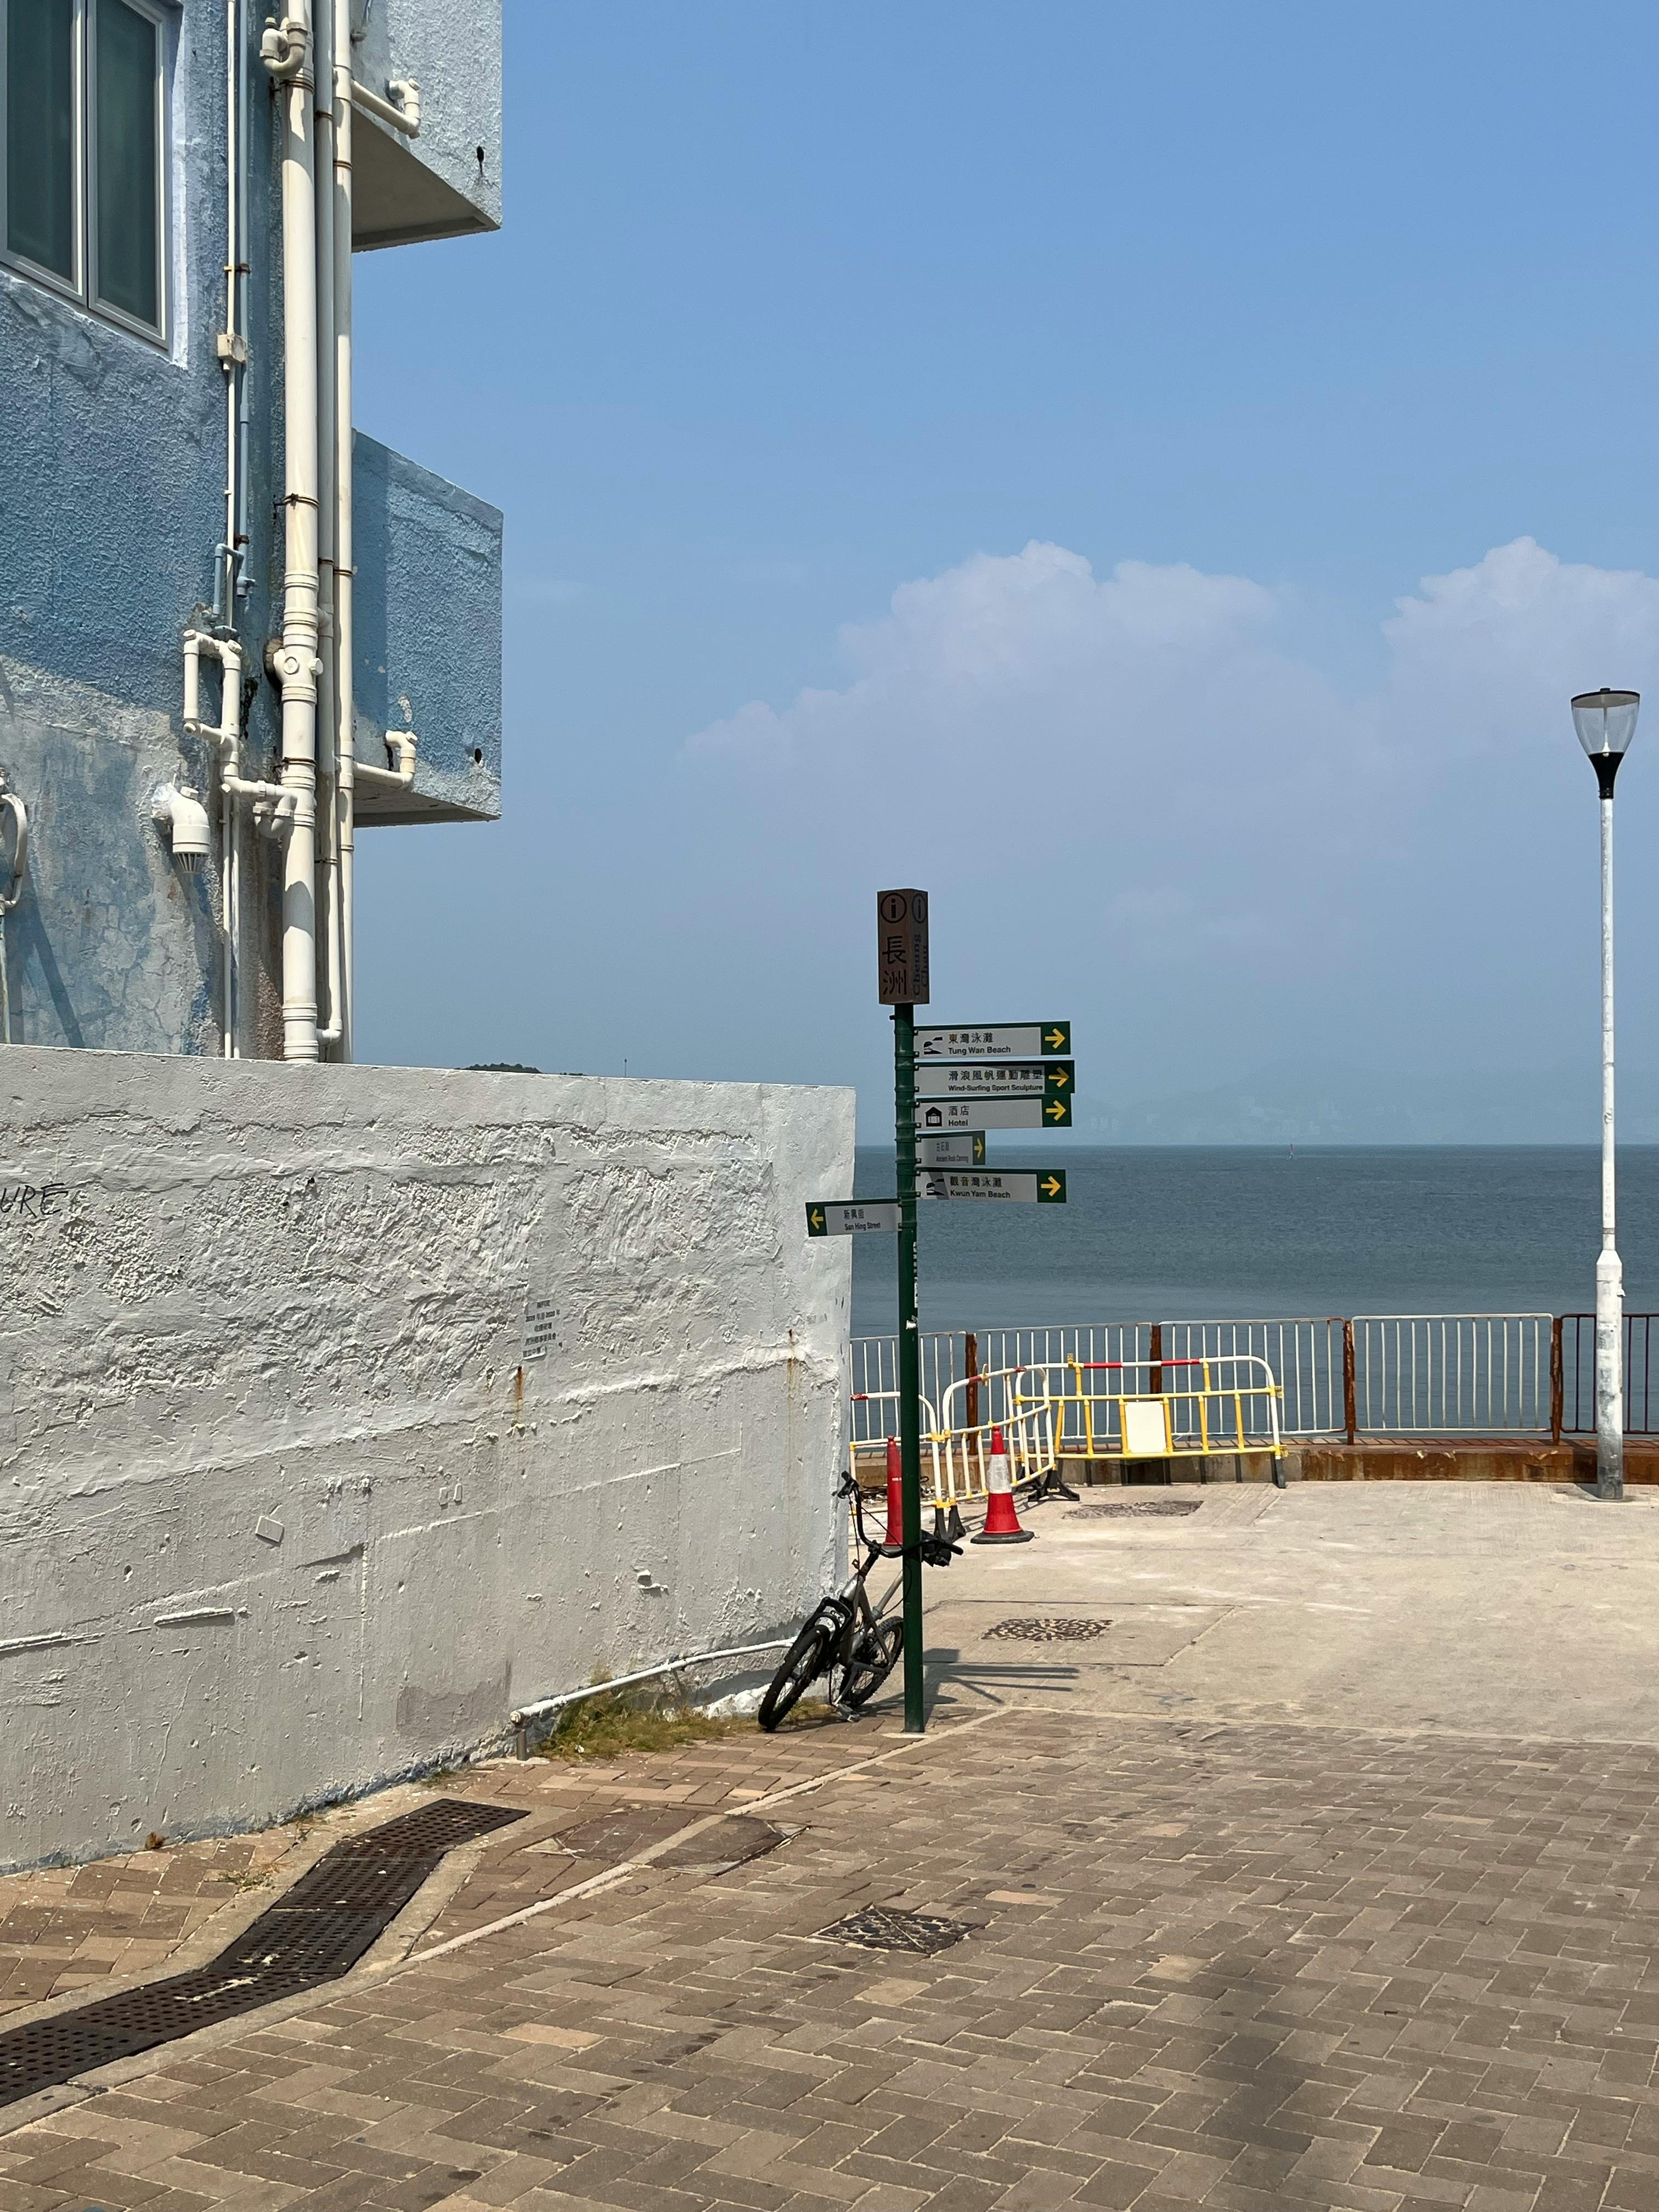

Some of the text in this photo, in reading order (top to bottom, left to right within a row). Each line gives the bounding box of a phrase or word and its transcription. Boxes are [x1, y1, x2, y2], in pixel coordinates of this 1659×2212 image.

[882, 935, 907, 995] 長洲
[913, 934, 921, 996] Cheung
[948, 1032, 994, 1044] 東灣泳灘
[948, 1047, 967, 1056] Tung
[948, 1070, 1042, 1081] 滑浪風帆運動雕塑
[948, 1105, 970, 1116] 酒店
[950, 1176, 1002, 1187] 觀音灣泳灘
